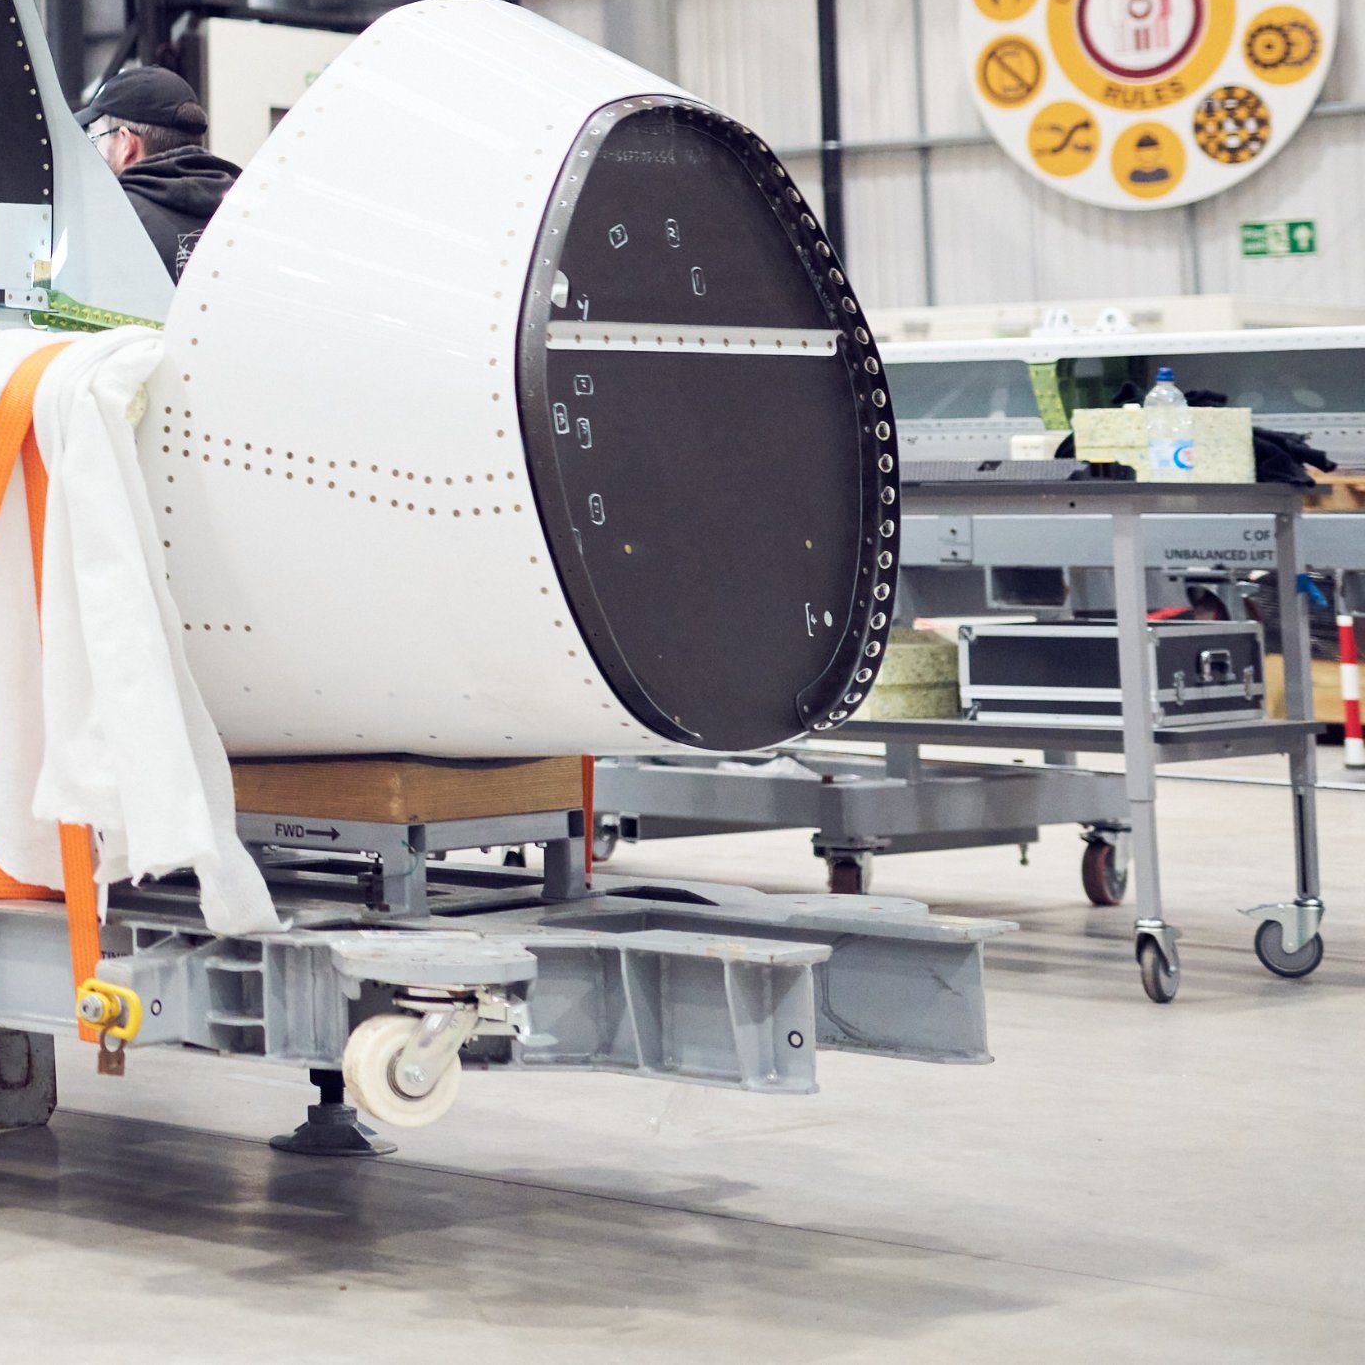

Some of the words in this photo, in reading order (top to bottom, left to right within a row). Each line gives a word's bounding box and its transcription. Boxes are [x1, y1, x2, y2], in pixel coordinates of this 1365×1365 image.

[1104, 77, 1186, 107] RULES
[1165, 549, 1247, 561] UNBALANCED
[1250, 550, 1274, 561] LIFT
[275, 823, 305, 838] FWD
